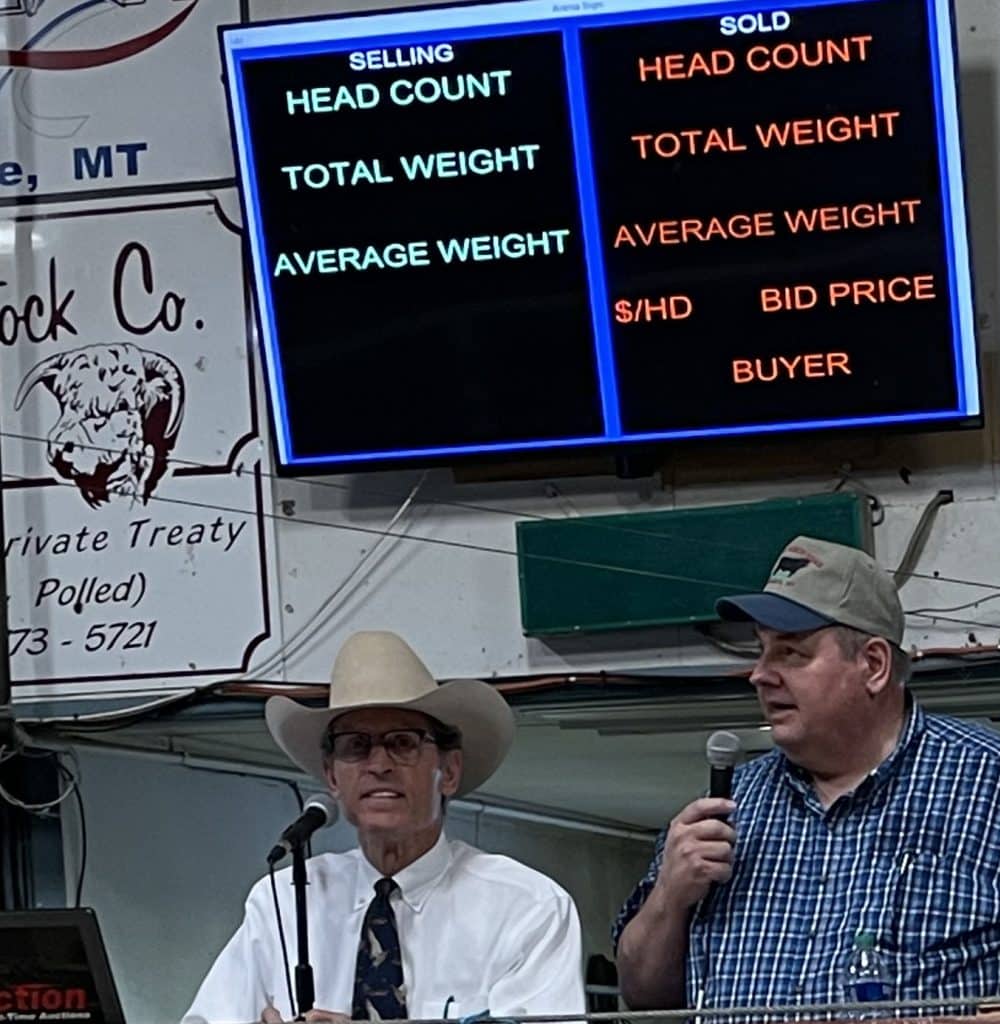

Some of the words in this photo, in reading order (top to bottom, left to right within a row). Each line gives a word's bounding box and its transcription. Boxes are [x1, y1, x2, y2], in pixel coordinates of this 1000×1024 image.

[719, 11, 790, 36] SOLD
[349, 44, 454, 71] SELLING
[638, 50, 736, 82] HEAD
[746, 35, 873, 73] COUNT
[286, 83, 380, 115] HEAD
[390, 70, 512, 105] COUNT
[631, 127, 747, 159] TOTAL
[755, 111, 901, 148] WEIGHT
[73, 142, 148, 180] MT
[281, 158, 394, 190] TOTAL
[400, 144, 540, 181] WEIGHT
[613, 212, 776, 249] AVERAGE
[783, 200, 921, 234] WEIGHT
[273, 242, 430, 278] AVERAGE
[436, 229, 570, 263] WEIGHT
[0, 256, 78, 346] ock
[113, 241, 205, 336] Co.
[614, 296, 693, 324] $/HD
[759, 285, 817, 313] BID
[829, 275, 937, 307] PRICE
[732, 352, 852, 384] BUYER
[5, 525, 109, 558] rivate
[129, 516, 247, 552] Treaty
[35, 571, 147, 608] Polled)
[8, 628, 49, 657] 73
[84, 620, 158, 652] 5721
